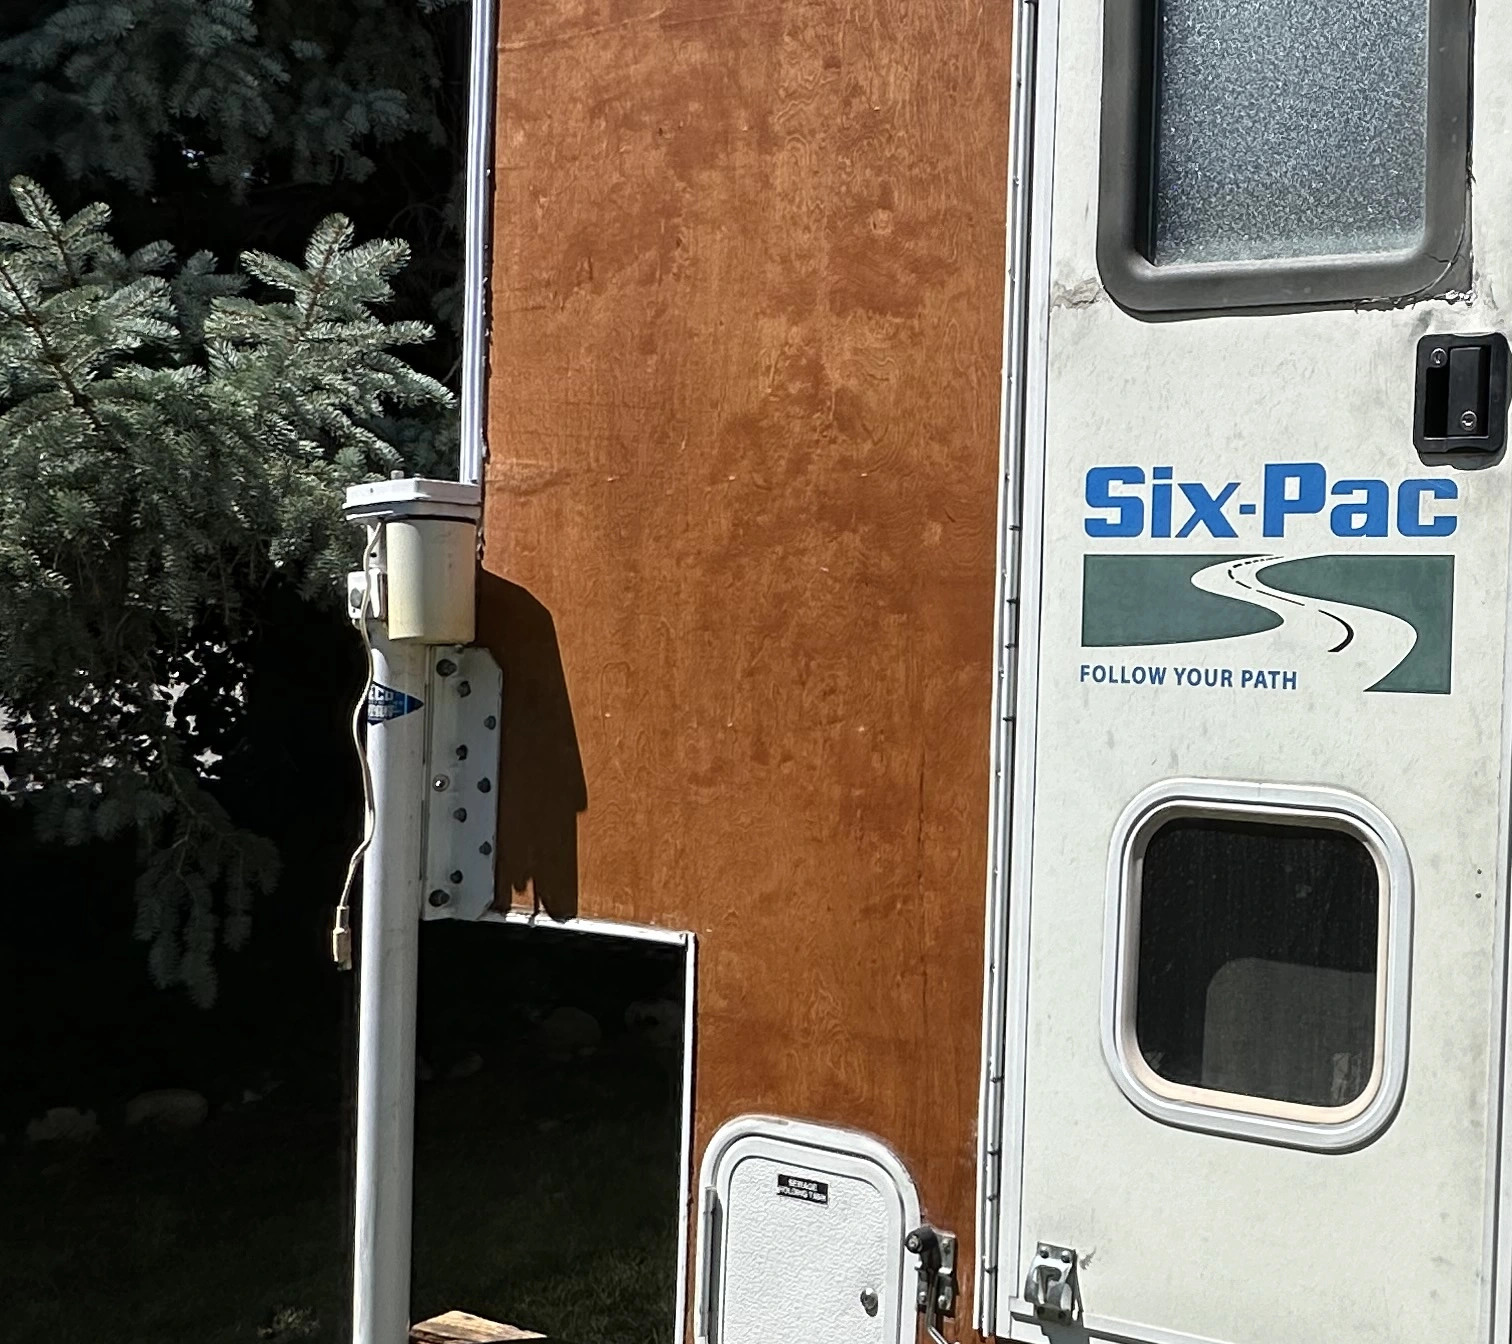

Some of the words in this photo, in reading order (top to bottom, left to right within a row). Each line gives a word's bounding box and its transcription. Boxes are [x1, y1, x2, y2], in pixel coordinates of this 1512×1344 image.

[1084, 462, 1458, 538] Six-Pac
[1079, 664, 1167, 685] FOLLOW
[1173, 667, 1233, 688] YOUR
[1241, 669, 1297, 690] PATH
